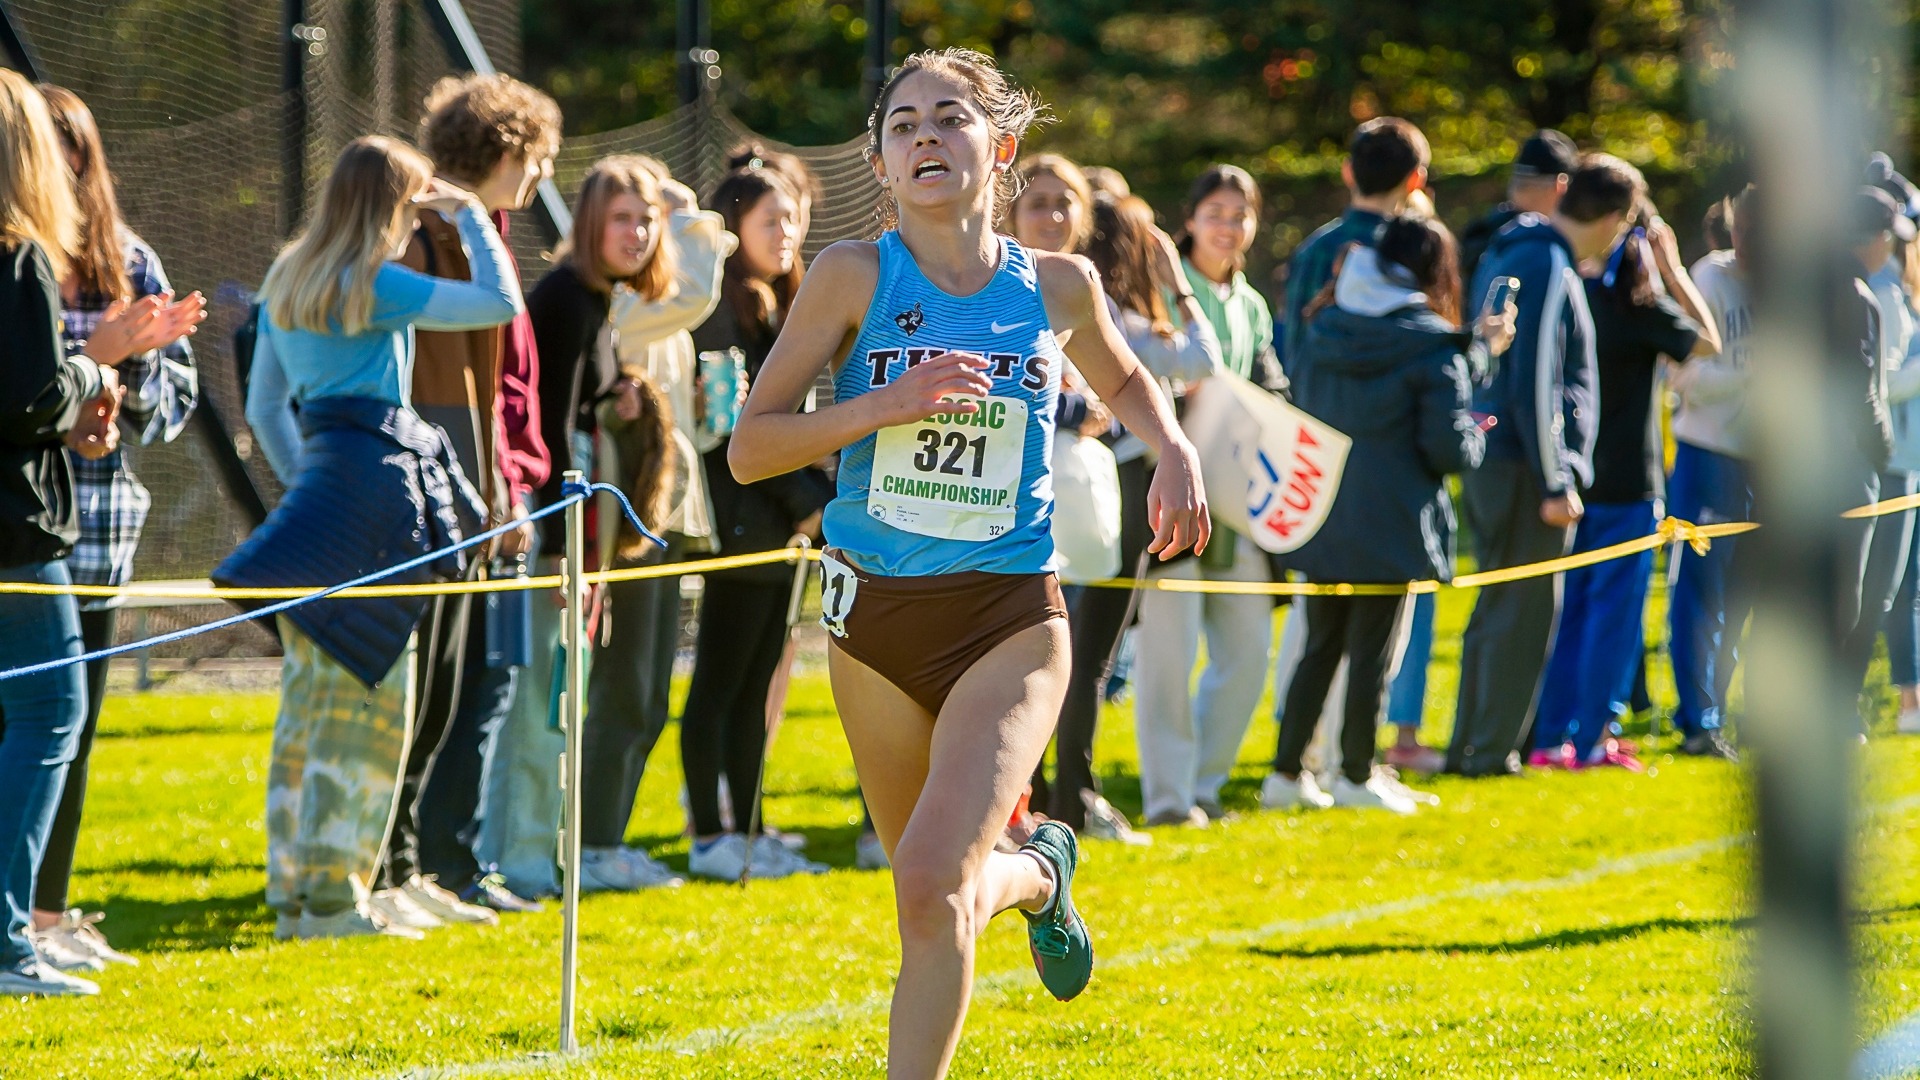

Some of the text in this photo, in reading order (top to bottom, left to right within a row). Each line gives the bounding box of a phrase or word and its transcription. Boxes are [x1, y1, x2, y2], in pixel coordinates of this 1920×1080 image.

[867, 350, 1049, 391] TTS
[913, 429, 987, 478] 321
[882, 474, 1008, 506] CHAMPIONSHIP
